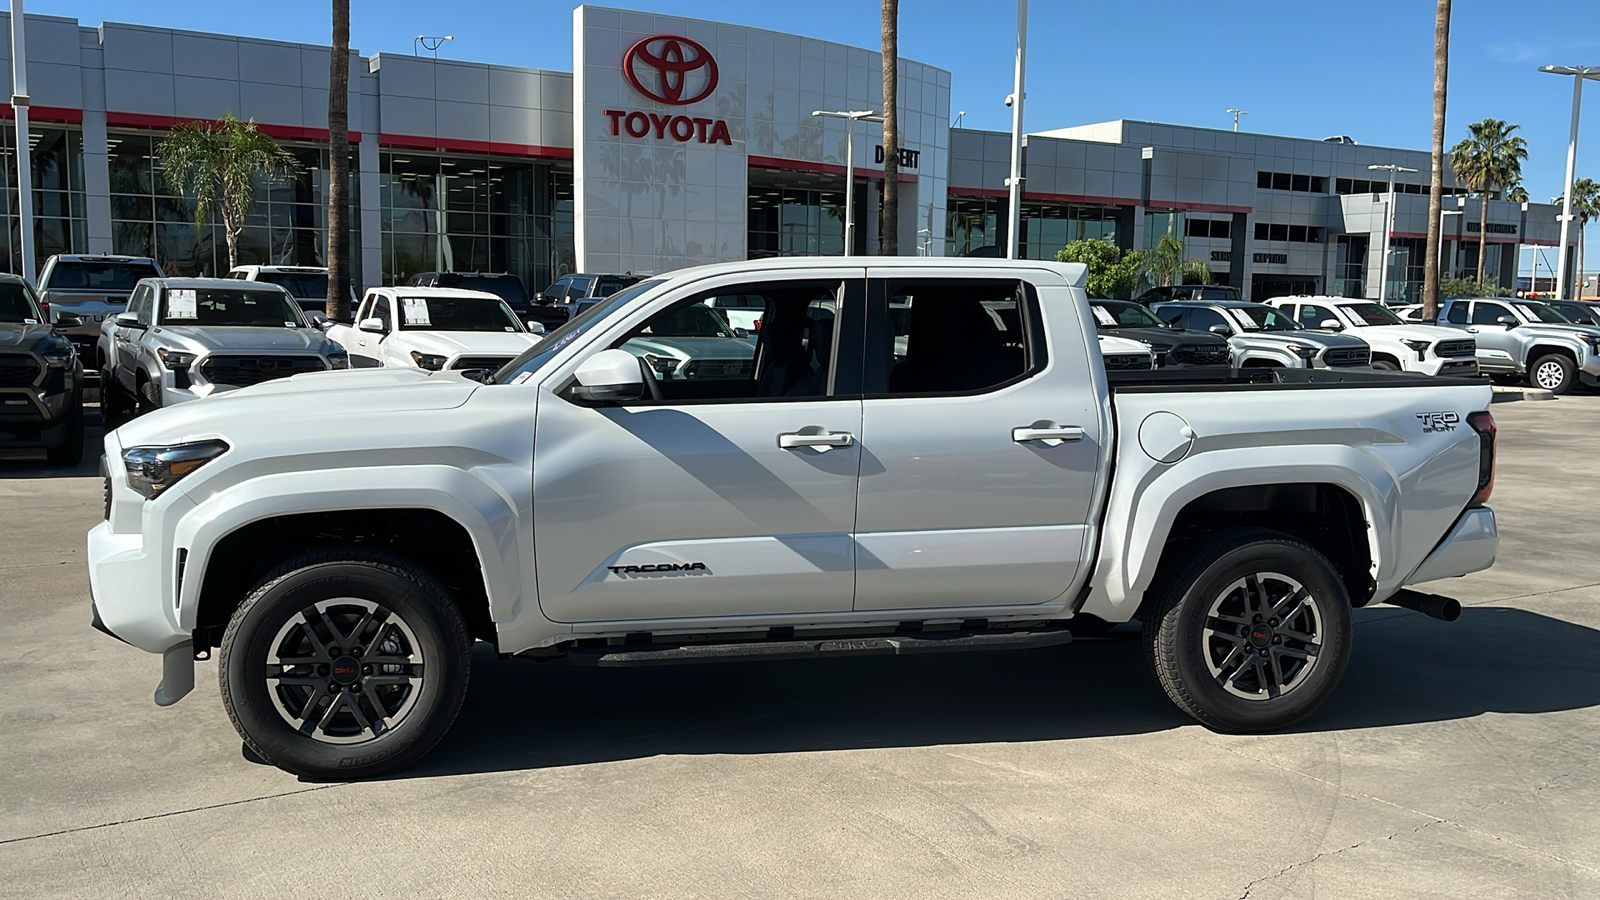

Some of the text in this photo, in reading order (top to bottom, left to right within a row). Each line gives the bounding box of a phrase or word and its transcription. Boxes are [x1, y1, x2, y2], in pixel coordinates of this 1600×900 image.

[604, 109, 732, 146] TOYOTA
[1415, 411, 1459, 428] TRD
[607, 562, 707, 574] TACOMA
